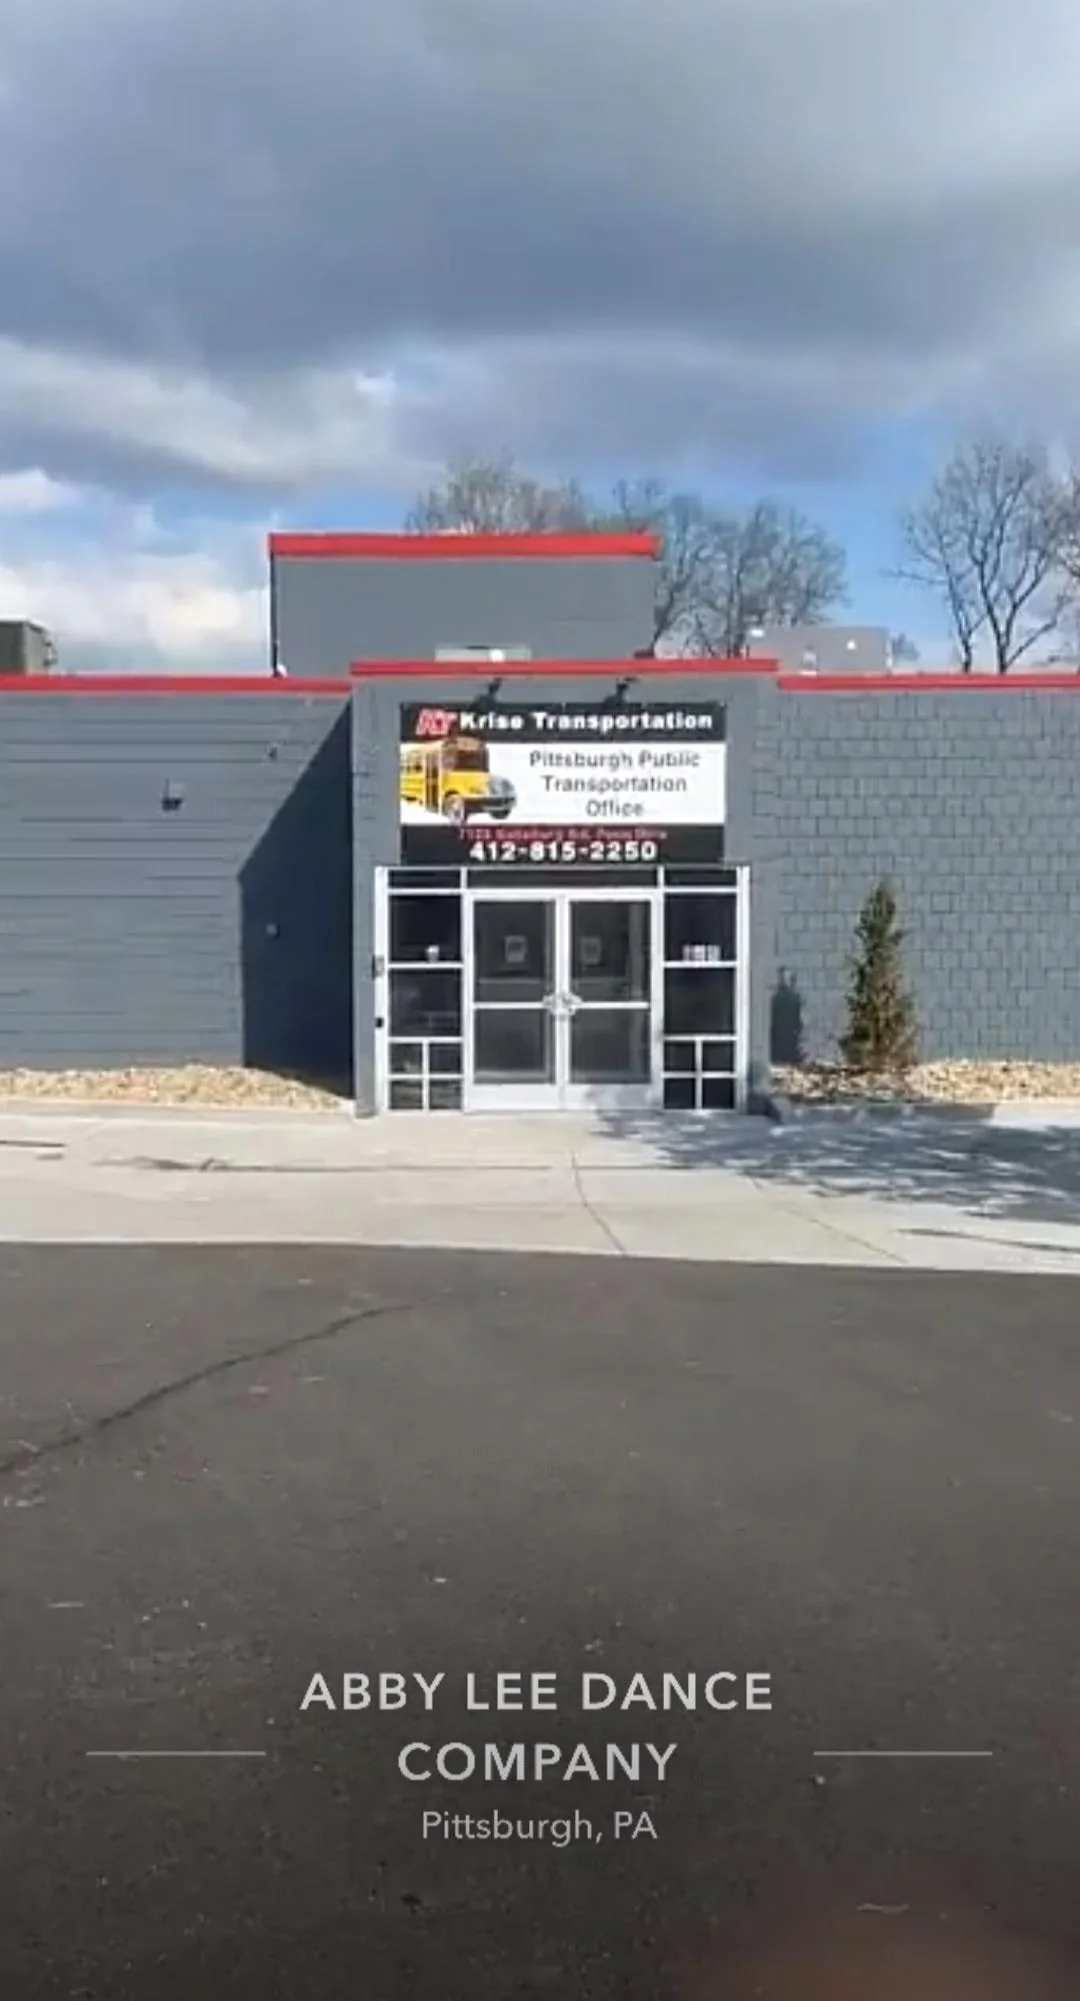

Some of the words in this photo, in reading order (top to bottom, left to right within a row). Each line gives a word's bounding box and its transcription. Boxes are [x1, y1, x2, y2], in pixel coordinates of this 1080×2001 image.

[460, 711, 523, 730] Krise
[533, 711, 713, 733] Transportation
[529, 750, 633, 771] Pittsburgh
[638, 750, 701, 768] Public
[542, 774, 687, 795] Transportation
[586, 799, 644, 817] Office
[469, 840, 658, 862] 412-815-2250
